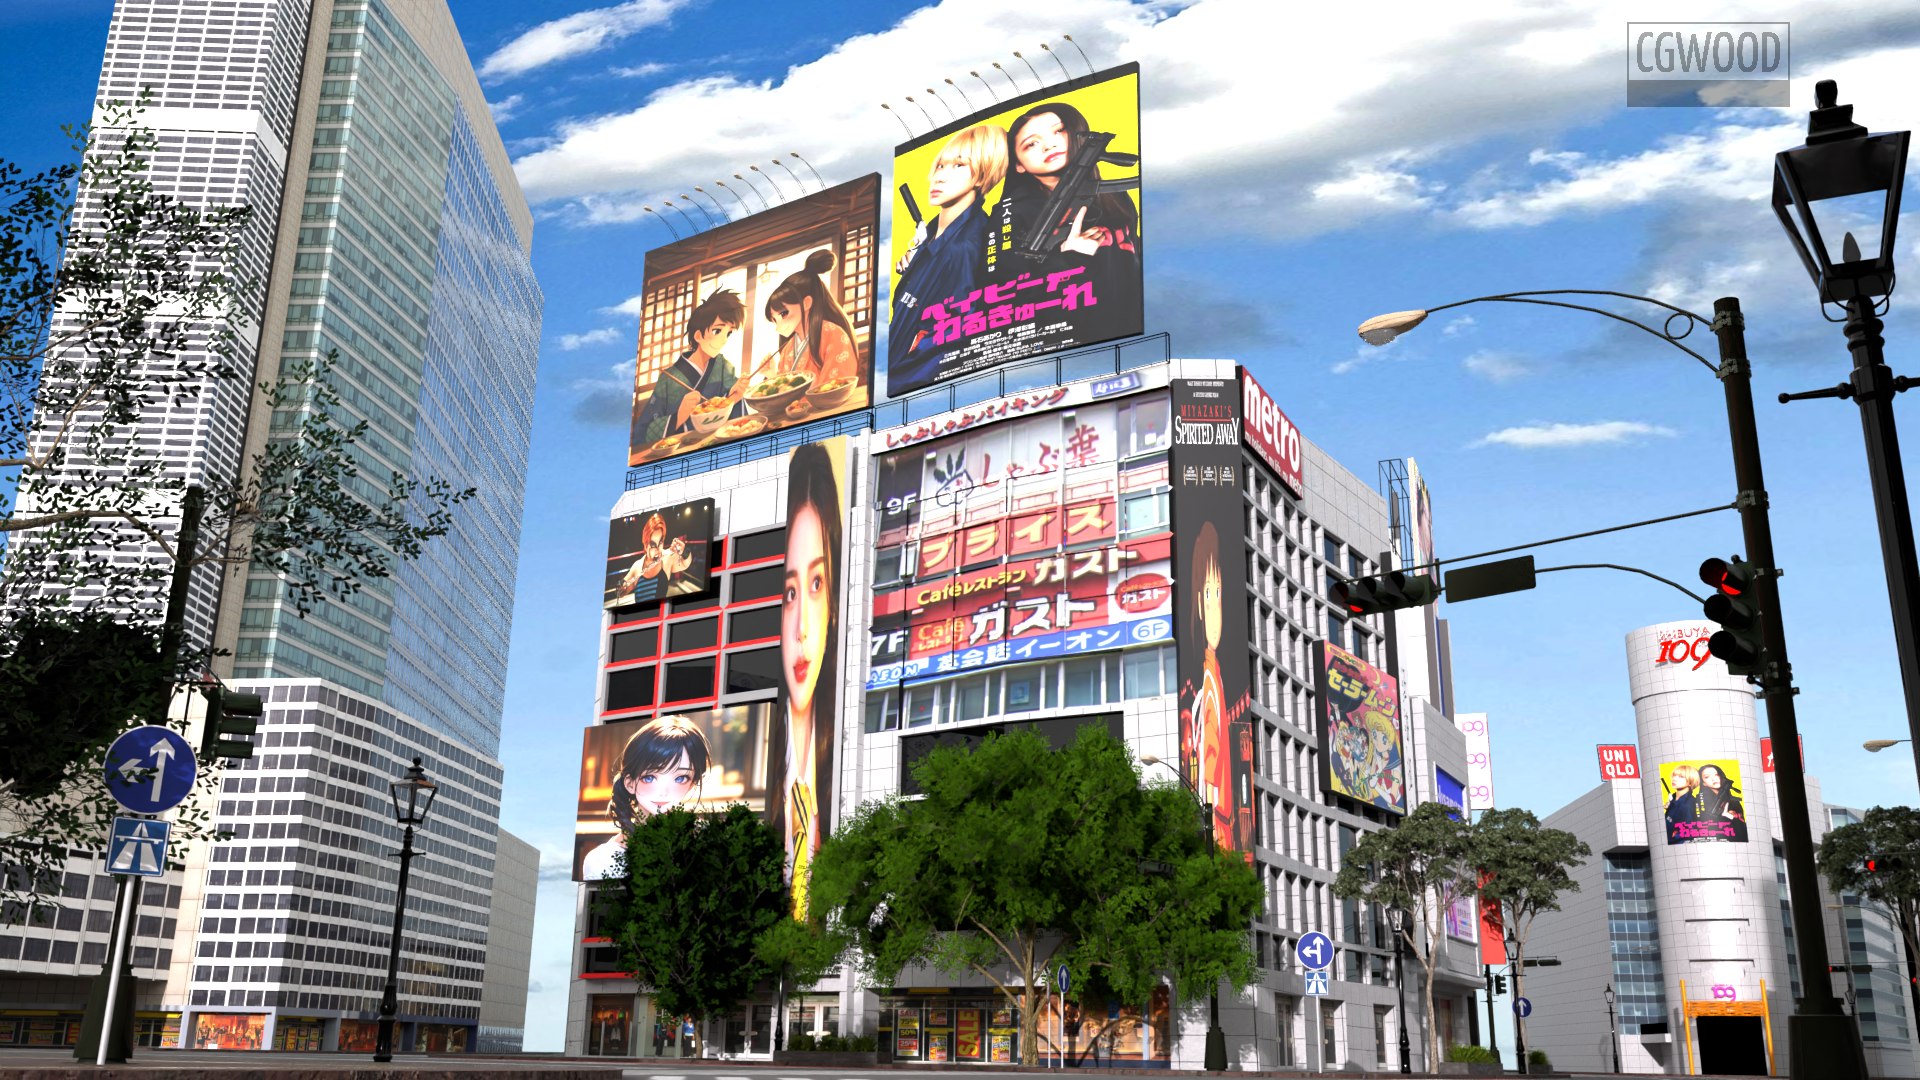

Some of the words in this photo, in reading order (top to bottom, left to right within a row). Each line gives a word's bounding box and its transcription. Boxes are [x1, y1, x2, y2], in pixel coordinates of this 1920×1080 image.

[932, 281, 1097, 345] わるきゅーれ
[886, 387, 1070, 447] しゃぶしゃぶバイキング
[1180, 404, 1233, 417] MIYAZAKI'S
[1244, 375, 1300, 473] metro
[1175, 415, 1214, 445] SPIRITED
[1215, 417, 1240, 446] AWAY
[886, 492, 917, 515] 9F
[1033, 543, 1138, 585] ガスト
[1121, 588, 1167, 604] ガスト
[969, 593, 1097, 645] ガスト
[1137, 622, 1164, 638] 6F
[871, 630, 909, 656] 7F
[1655, 637, 1711, 671] 109
[1328, 668, 1396, 717] セーラームーン
[1466, 753, 1487, 769] 09
[1603, 749, 1630, 762] UNI
[1605, 764, 1635, 776] QLO
[1469, 786, 1489, 802] 09
[958, 1010, 979, 1056] SALE
